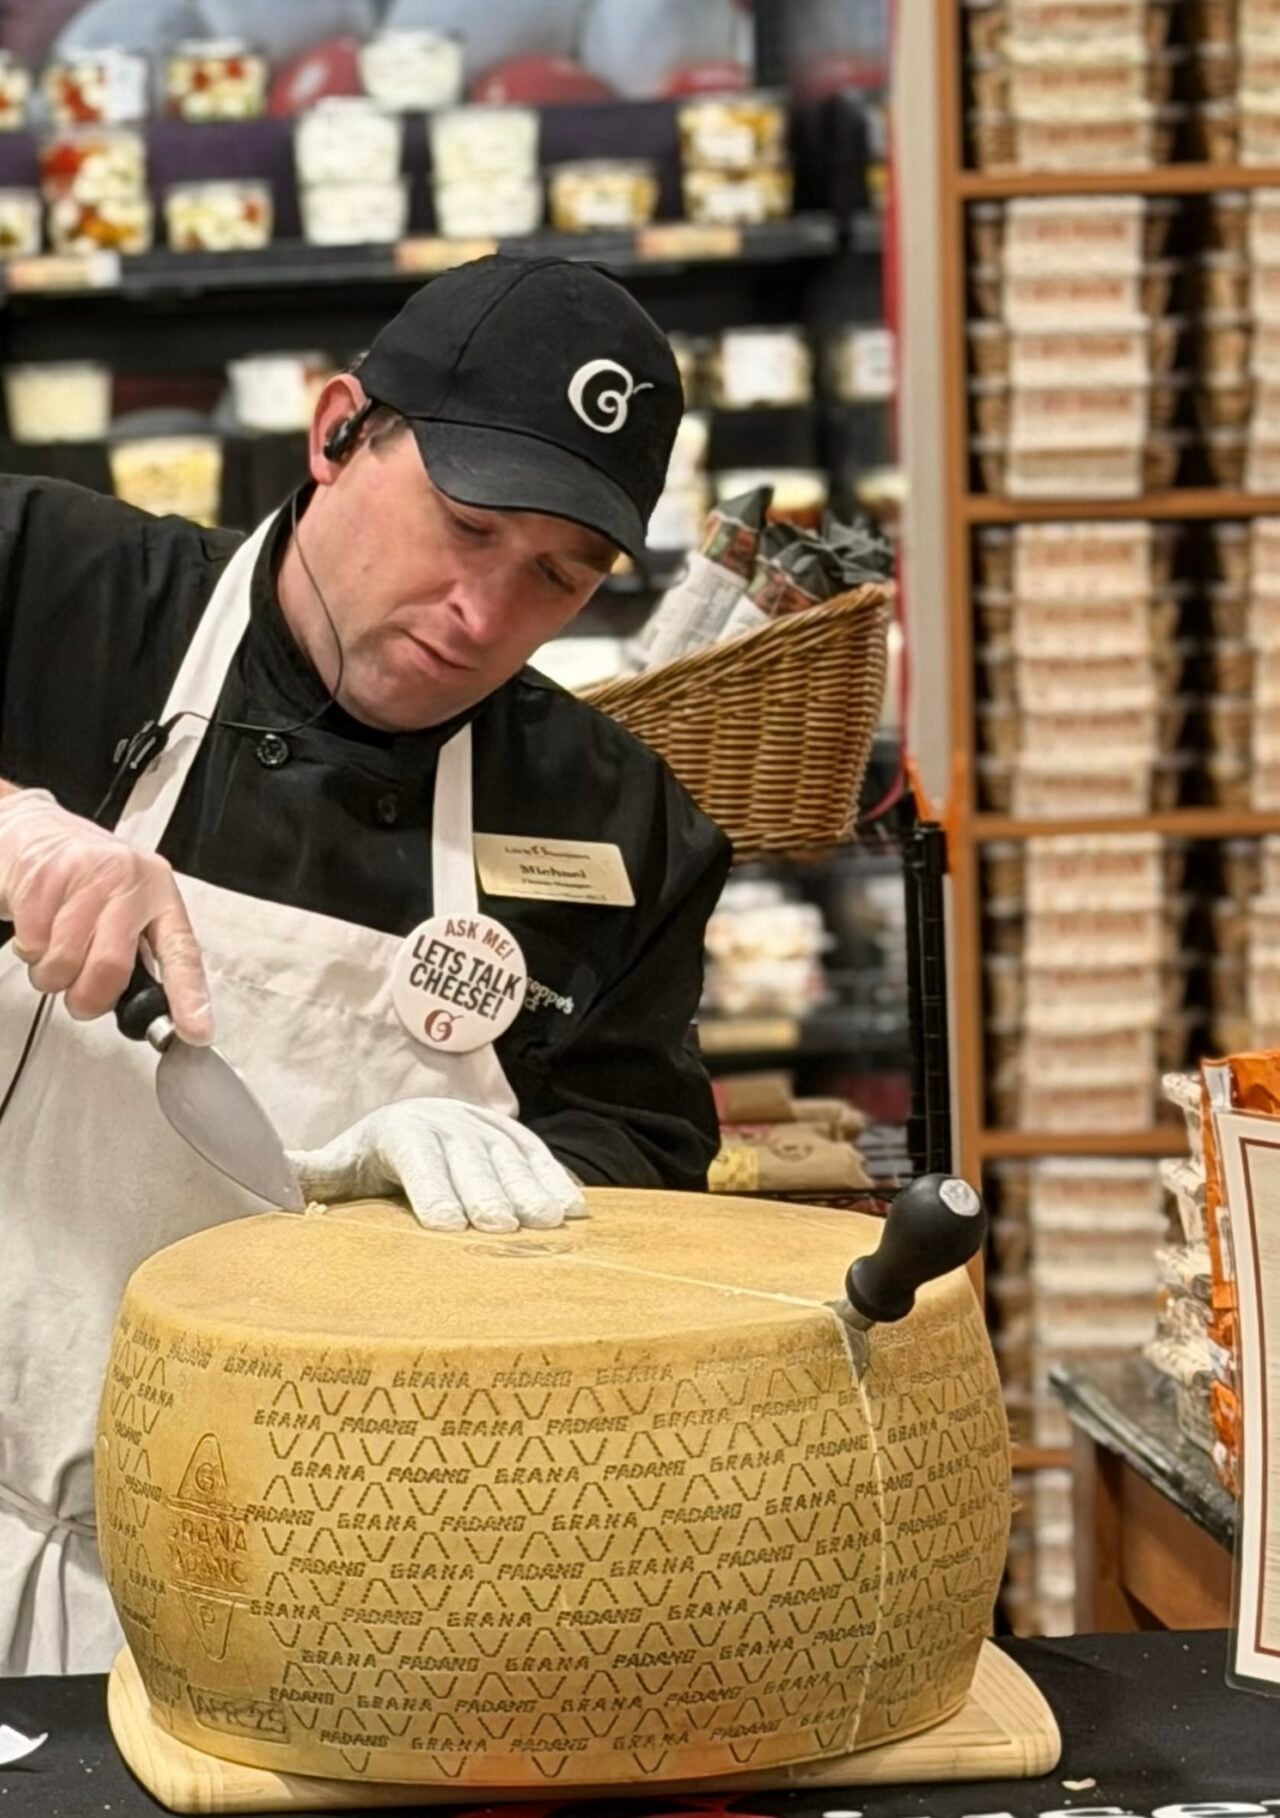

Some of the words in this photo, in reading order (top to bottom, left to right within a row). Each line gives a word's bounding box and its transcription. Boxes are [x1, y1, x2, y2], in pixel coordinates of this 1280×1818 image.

[445, 919, 480, 940] ASK
[482, 927, 515, 960] ME!
[412, 934, 467, 975] LETS
[468, 957, 522, 1000] TALK
[409, 962, 505, 1021] CHEESE!
[224, 1357, 283, 1378] GRANA
[300, 1366, 373, 1385] PADANO
[392, 1371, 470, 1388] GRANA
[491, 1371, 572, 1388] PADANO
[595, 1364, 672, 1385] GRANA
[137, 1384, 175, 1409] GRANA
[254, 1410, 321, 1430] GRANA
[340, 1417, 418, 1436] PADANO
[440, 1419, 523, 1436] GRANA
[547, 1416, 628, 1434] PADANO
[653, 1409, 731, 1429] GRANA
[750, 1396, 819, 1418] PADANO
[291, 1462, 365, 1481] GRANA
[386, 1467, 470, 1484] PADANO
[494, 1468, 579, 1484] GRANA
[603, 1460, 686, 1480] PADANO
[709, 1450, 786, 1473] GRANA
[805, 1436, 869, 1458] PADANO
[888, 1416, 938, 1442] GRANA
[242, 1505, 315, 1526] PADANO
[337, 1513, 418, 1532] GRANA
[439, 1515, 526, 1532] PADANO
[551, 1512, 638, 1531] GRANA
[661, 1503, 743, 1525] PADANO
[765, 1490, 837, 1515] GRANA
[289, 1556, 365, 1578] PADANO
[390, 1564, 474, 1580] GRANA
[497, 1564, 584, 1580] PADANO
[610, 1556, 695, 1577] GRANA
[716, 1545, 795, 1568] PADANO
[815, 1527, 883, 1556] GRANA
[250, 1600, 320, 1621] GRANA
[341, 1608, 424, 1626] PADANO
[446, 1611, 532, 1628] GRANA
[556, 1607, 642, 1626] PADANO
[668, 1599, 749, 1621] GRANA
[769, 1582, 841, 1610] PADANO
[300, 1650, 376, 1668] GRANA
[398, 1655, 479, 1671] PADANO
[505, 1657, 589, 1671] GRANA
[613, 1650, 697, 1668] PADANO
[720, 1637, 793, 1660] GRANA
[269, 1687, 334, 1705] PADANO
[357, 1695, 433, 1712] GRANA
[455, 1700, 536, 1714] PADANO
[561, 1696, 643, 1711] GRANA
[664, 1685, 743, 1707] PADANO
[763, 1671, 831, 1695] GRANA
[320, 1730, 388, 1747] PADANO
[412, 1737, 488, 1752] GRANA
[509, 1738, 589, 1750] PADANO
[614, 1732, 689, 1750] GRANA
